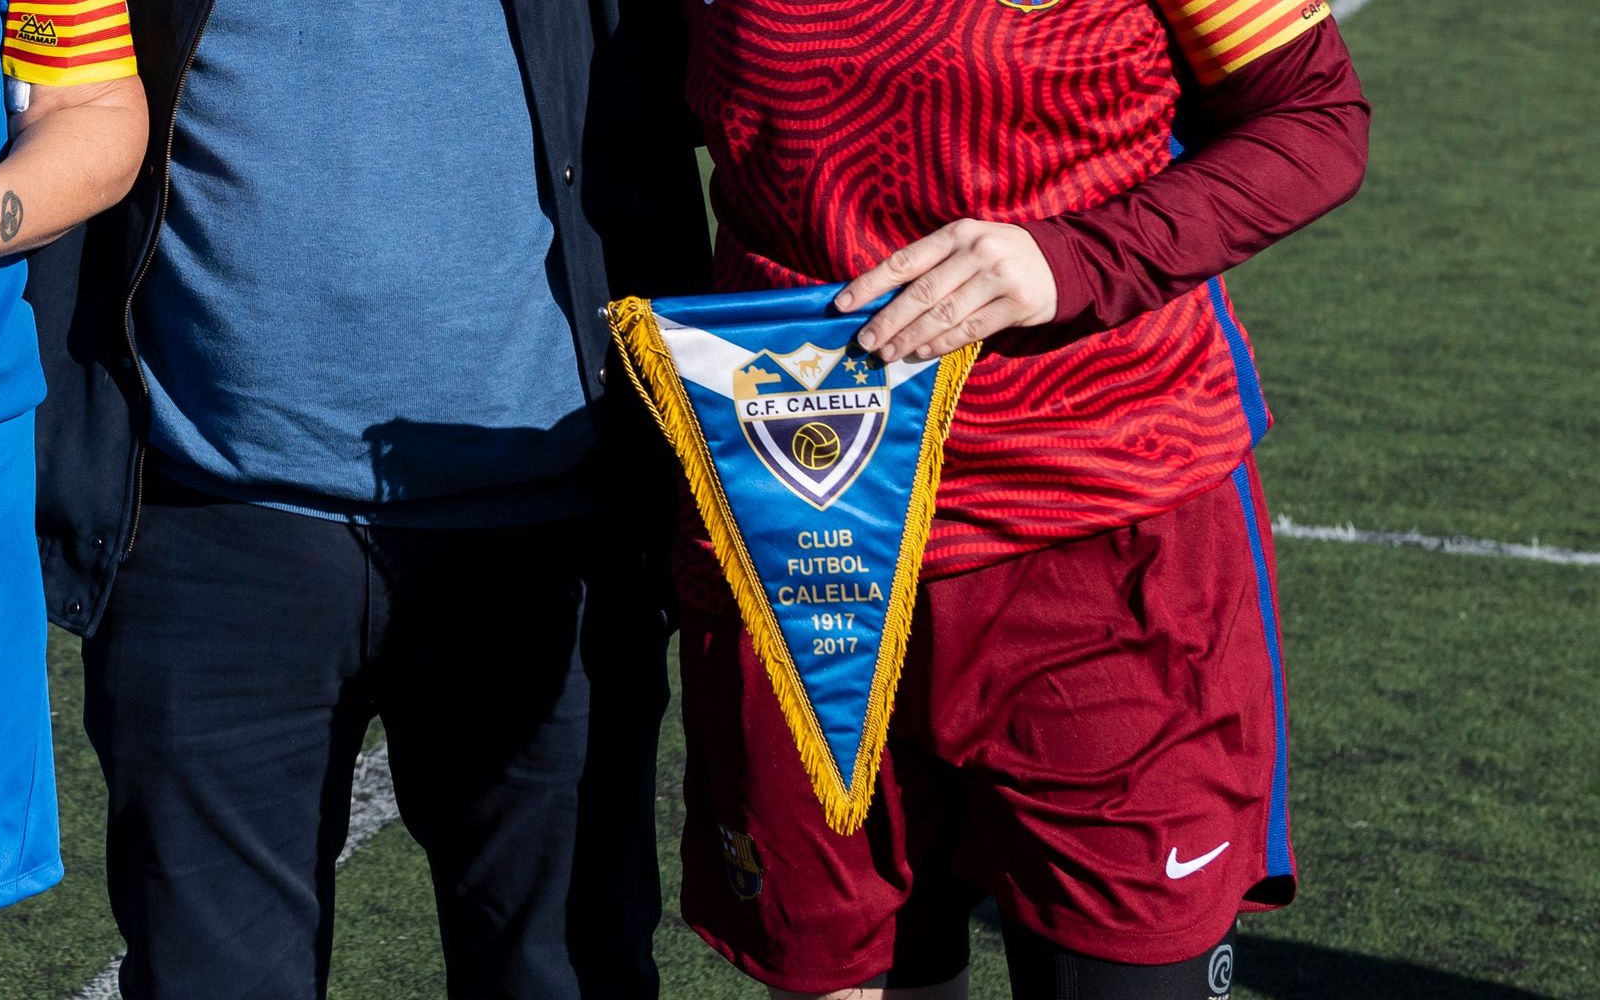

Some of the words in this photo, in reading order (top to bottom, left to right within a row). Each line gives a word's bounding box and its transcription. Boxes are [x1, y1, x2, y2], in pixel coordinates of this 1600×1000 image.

[17, 32, 57, 46] ARAMAR
[746, 400, 779, 416] C.F.
[787, 393, 881, 412] CALELLA
[798, 529, 853, 549] CLUB
[787, 555, 870, 576] FUTBOL
[778, 582, 884, 606] CALELLA
[811, 613, 855, 631] 1917
[812, 637, 858, 655] 2017
